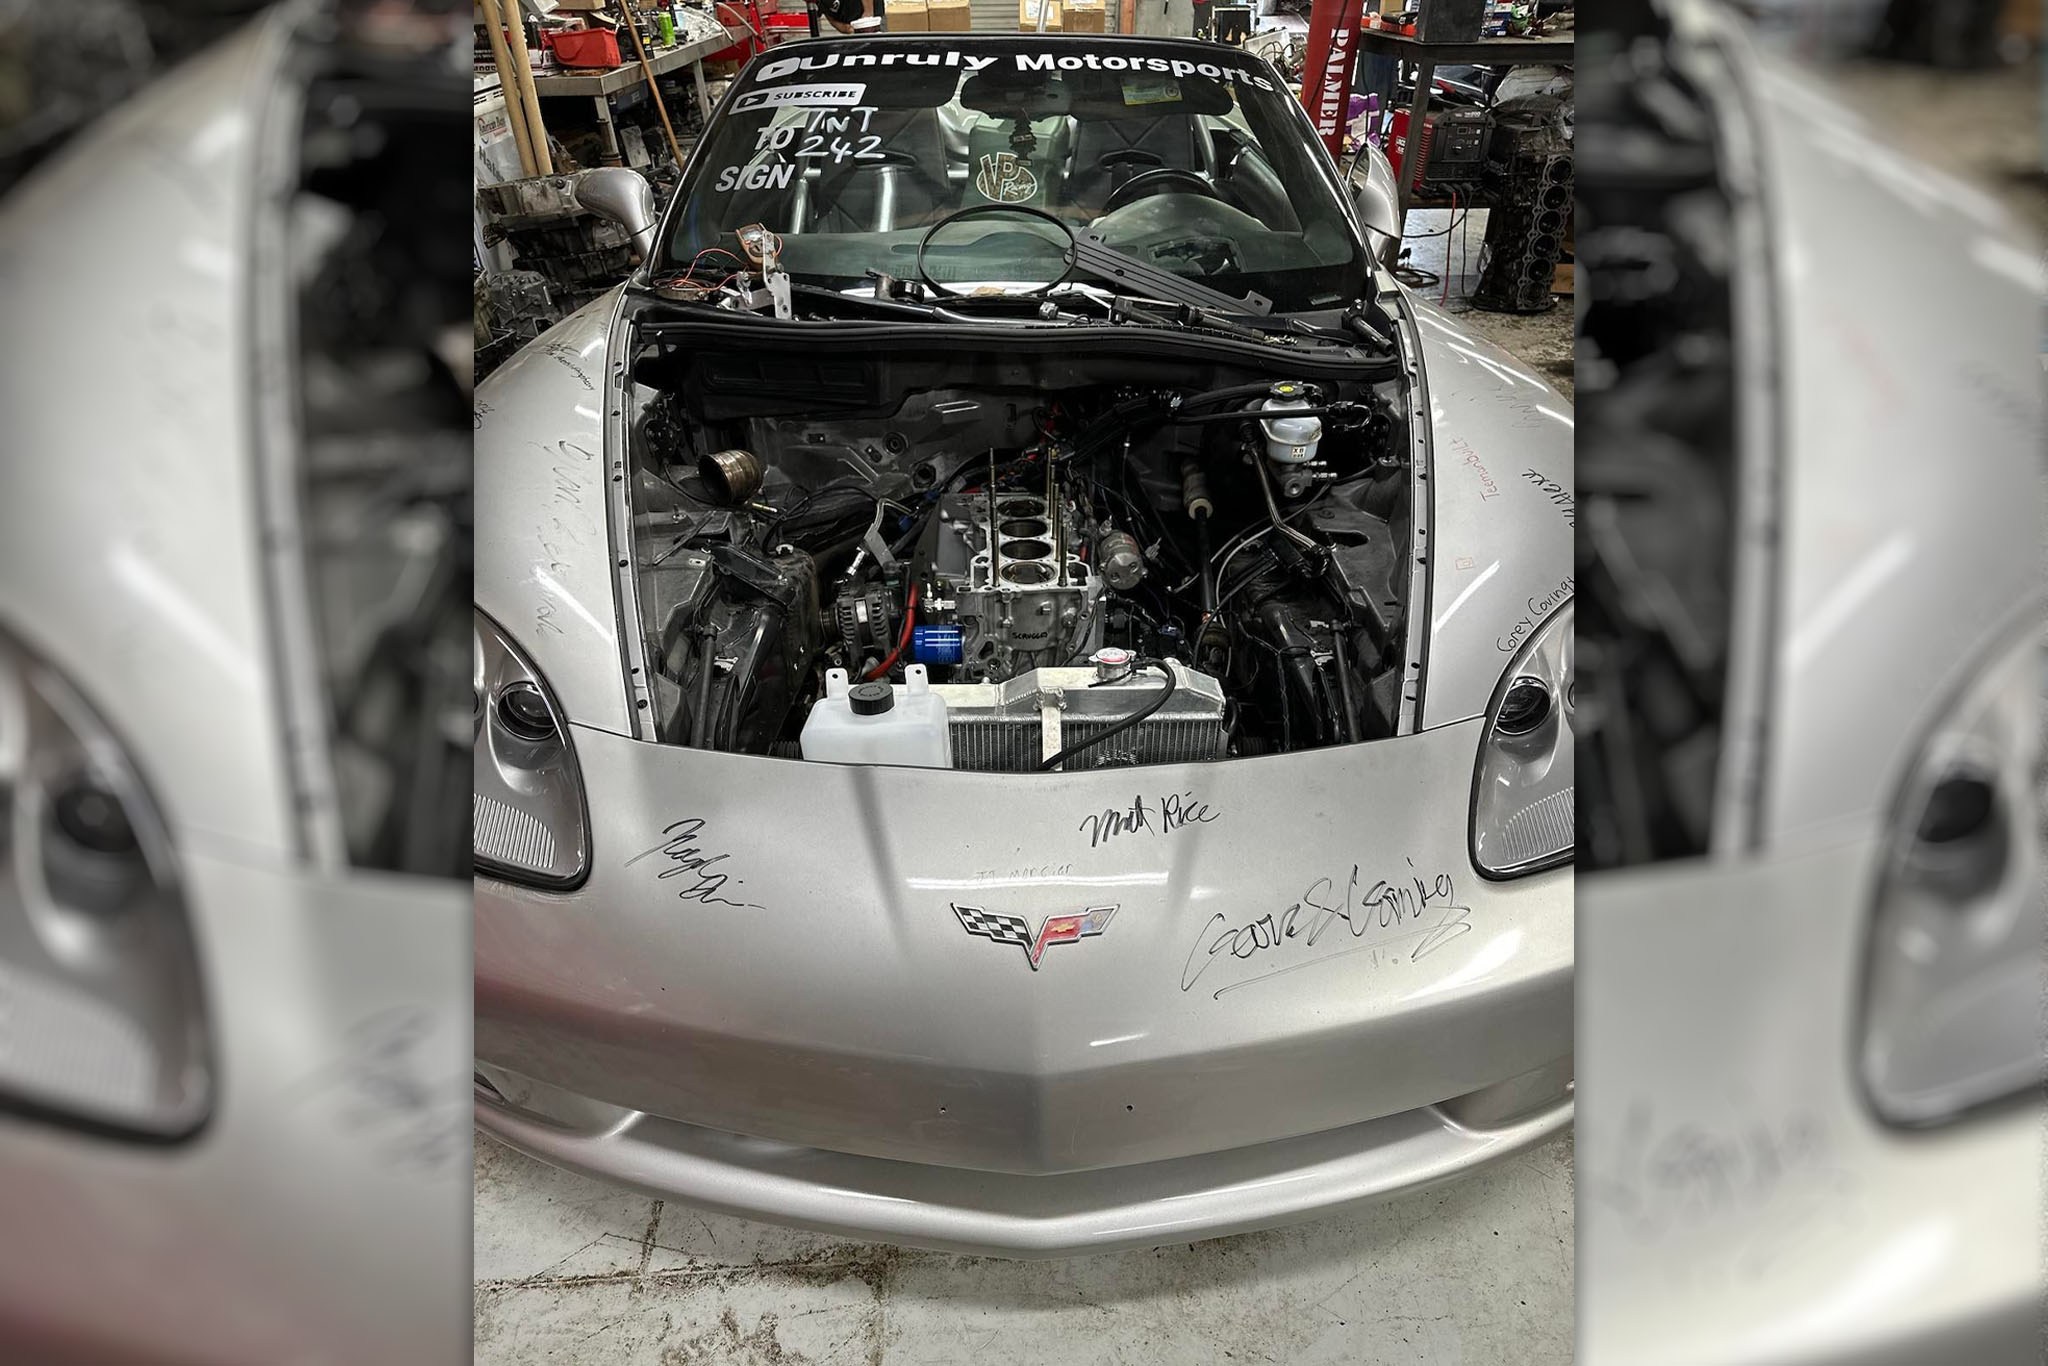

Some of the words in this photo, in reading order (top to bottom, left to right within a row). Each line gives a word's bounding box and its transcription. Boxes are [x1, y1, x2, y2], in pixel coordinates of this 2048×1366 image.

[799, 51, 999, 70] Unruly
[1015, 54, 1275, 92] Motorsports
[1318, 28, 1350, 136] PALMER
[774, 90, 857, 100] SUBSCRIBE
[754, 127, 796, 151] TO
[794, 135, 886, 164] 242
[715, 164, 796, 192] SIGN
[1496, 616, 1535, 652] Corey
[1161, 791, 1221, 833] Rice
